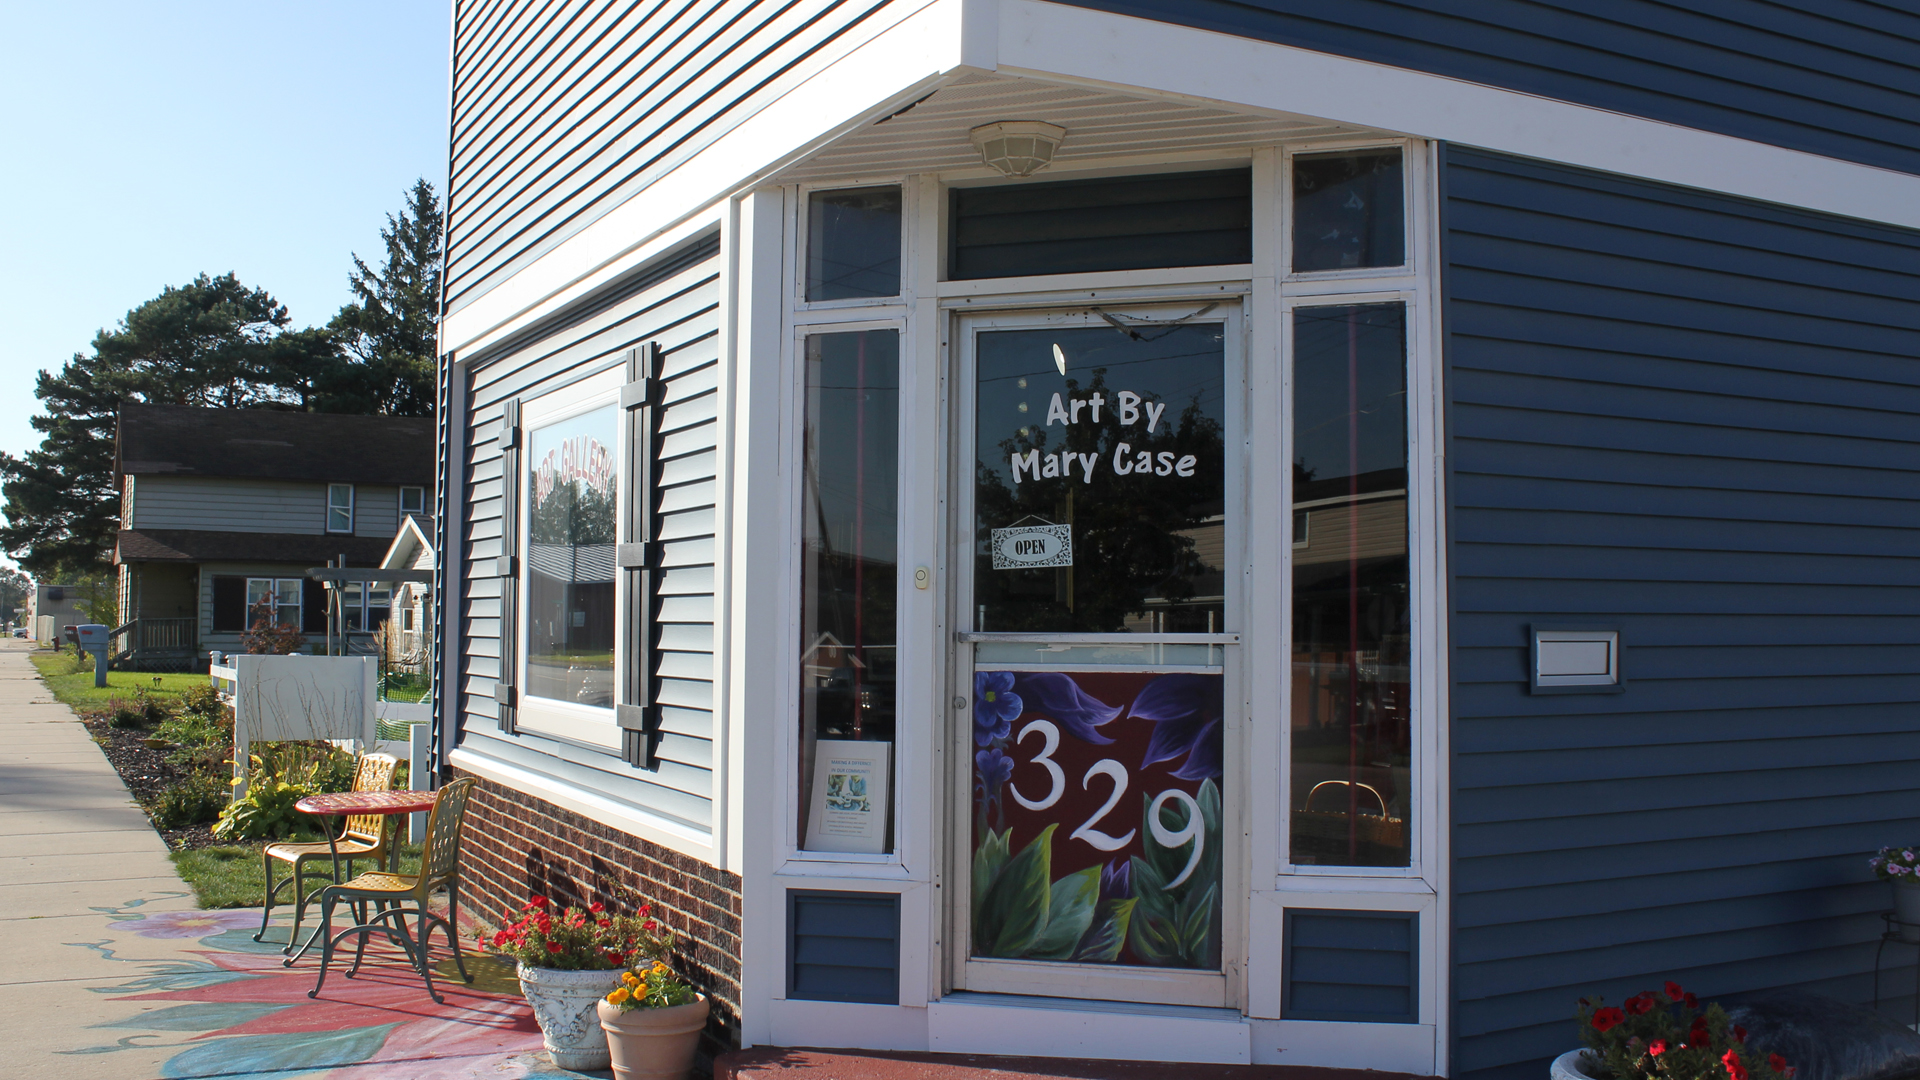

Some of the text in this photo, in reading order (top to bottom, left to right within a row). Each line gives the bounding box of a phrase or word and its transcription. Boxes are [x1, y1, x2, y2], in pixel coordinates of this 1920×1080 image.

[1047, 390, 1166, 434] Art By
[536, 433, 613, 510] ART GALLERY
[1011, 441, 1197, 484] Mary Case
[1015, 539, 1046, 556] OPEN
[1009, 719, 1205, 891] 329
